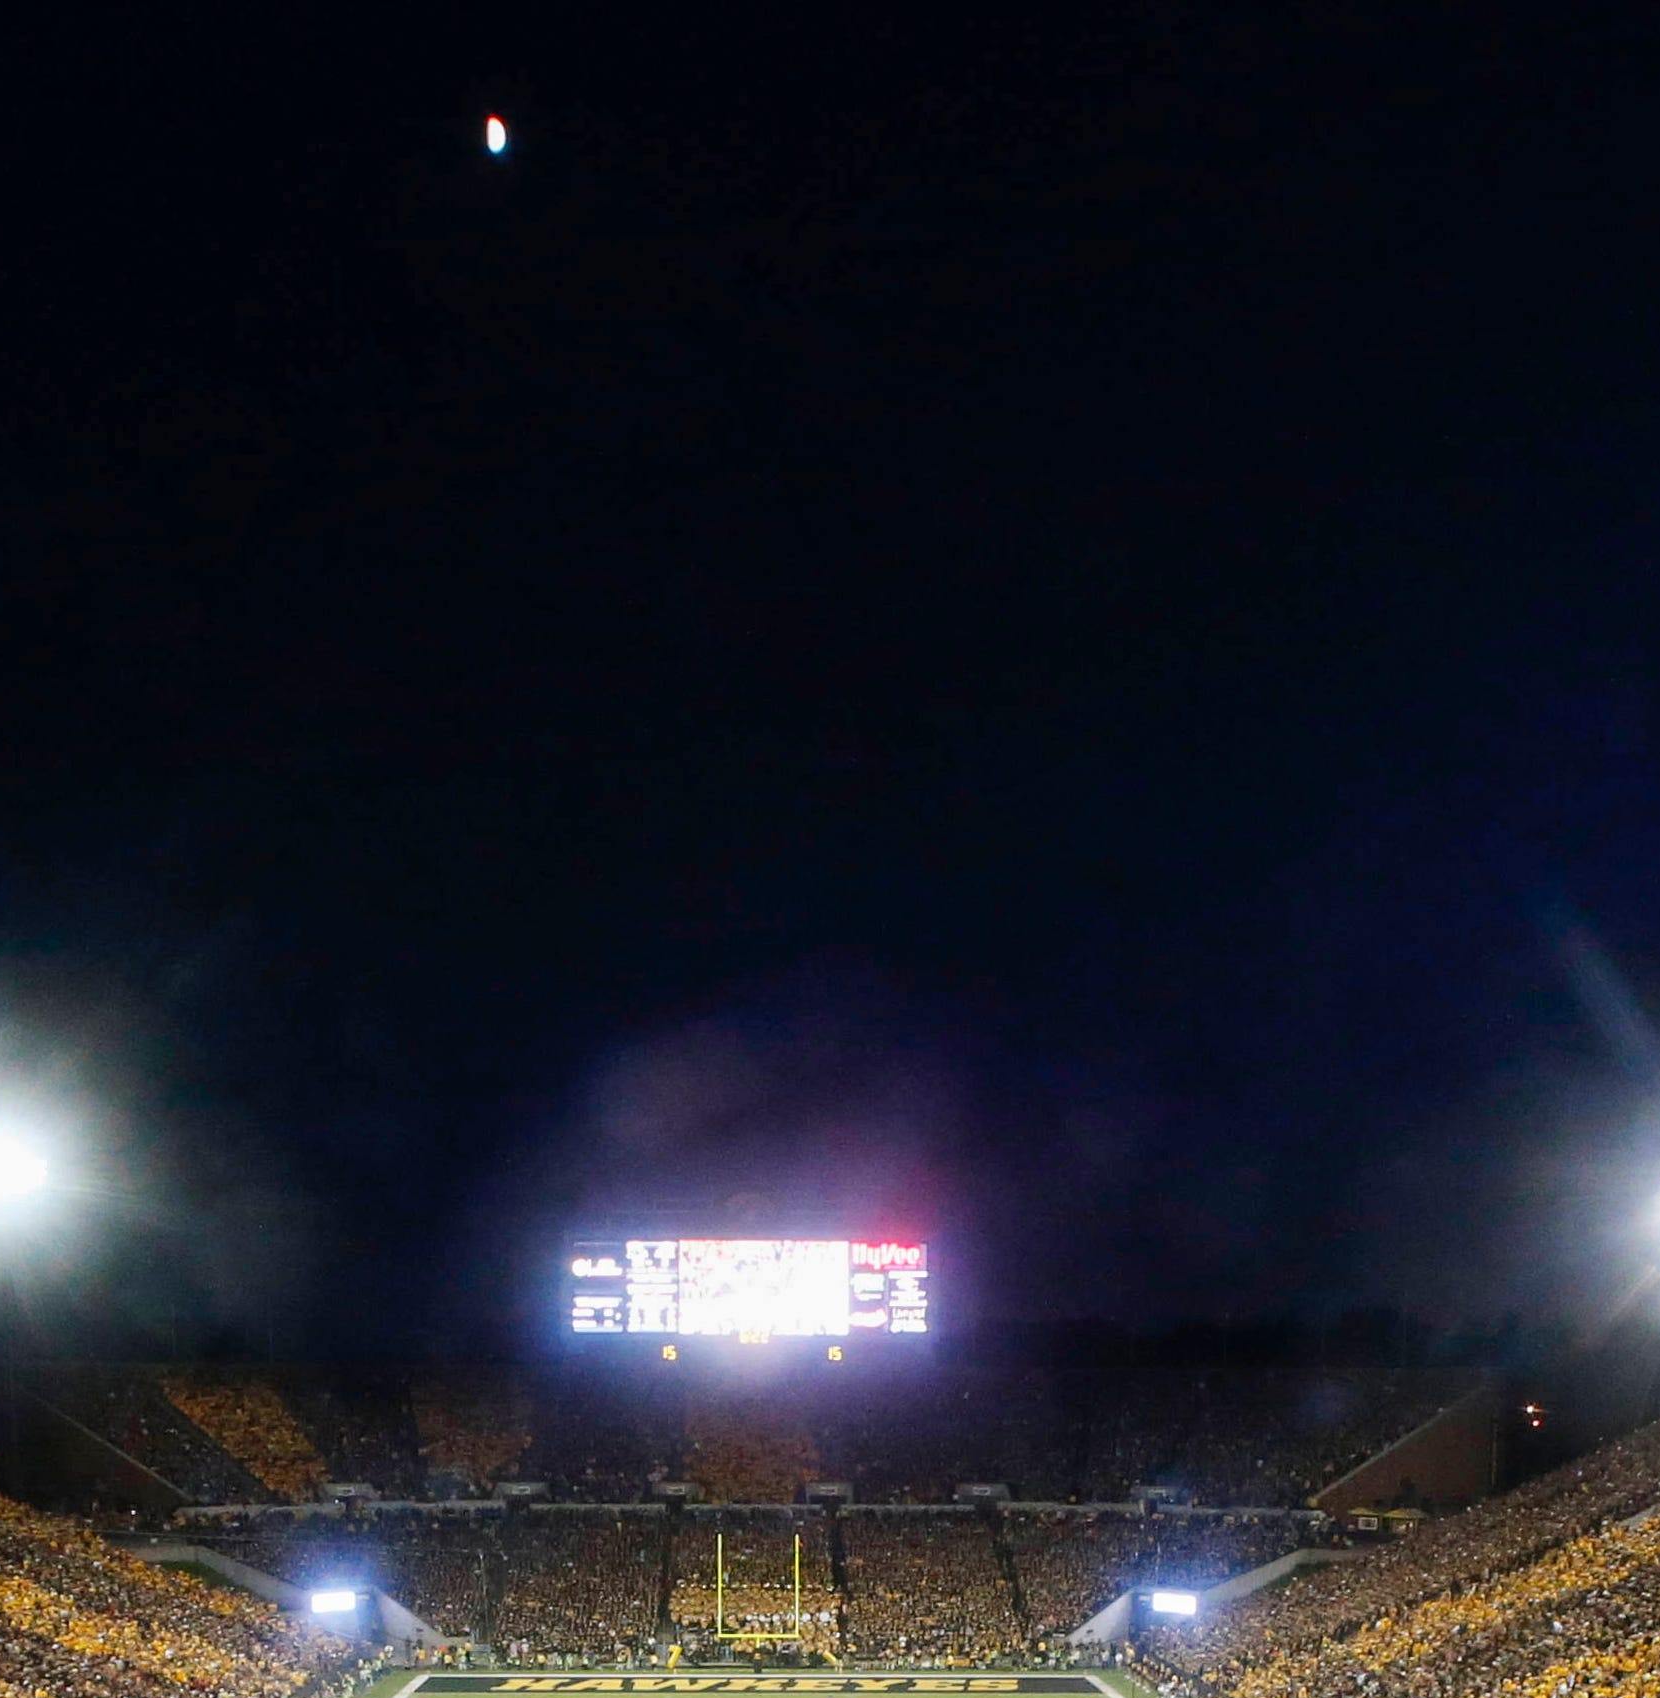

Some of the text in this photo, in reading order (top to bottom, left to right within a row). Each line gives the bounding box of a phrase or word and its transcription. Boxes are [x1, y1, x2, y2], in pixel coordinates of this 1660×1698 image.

[662, 1345, 677, 1360] 15
[827, 1346, 842, 1361] 15
[491, 1678, 1019, 1691] HAWKEYES
